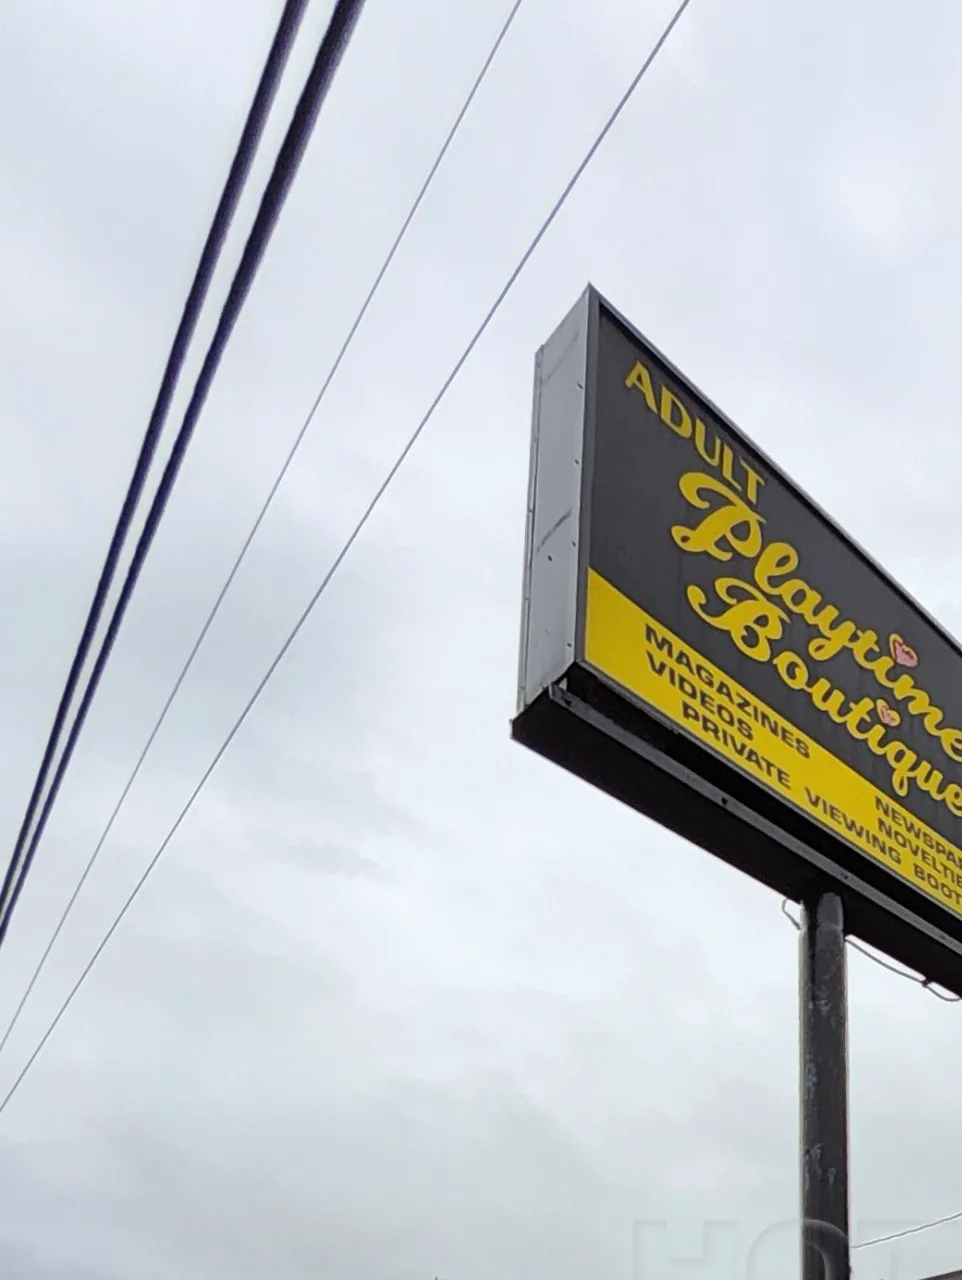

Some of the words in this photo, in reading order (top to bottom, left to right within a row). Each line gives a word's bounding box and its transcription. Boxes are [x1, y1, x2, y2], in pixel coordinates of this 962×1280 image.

[625, 360, 765, 506] ADULT
[645, 623, 811, 759] MAGAZINES
[646, 649, 754, 741] VIDEOS
[682, 701, 792, 790] PRIVATE
[804, 786, 902, 865] VIEWING
